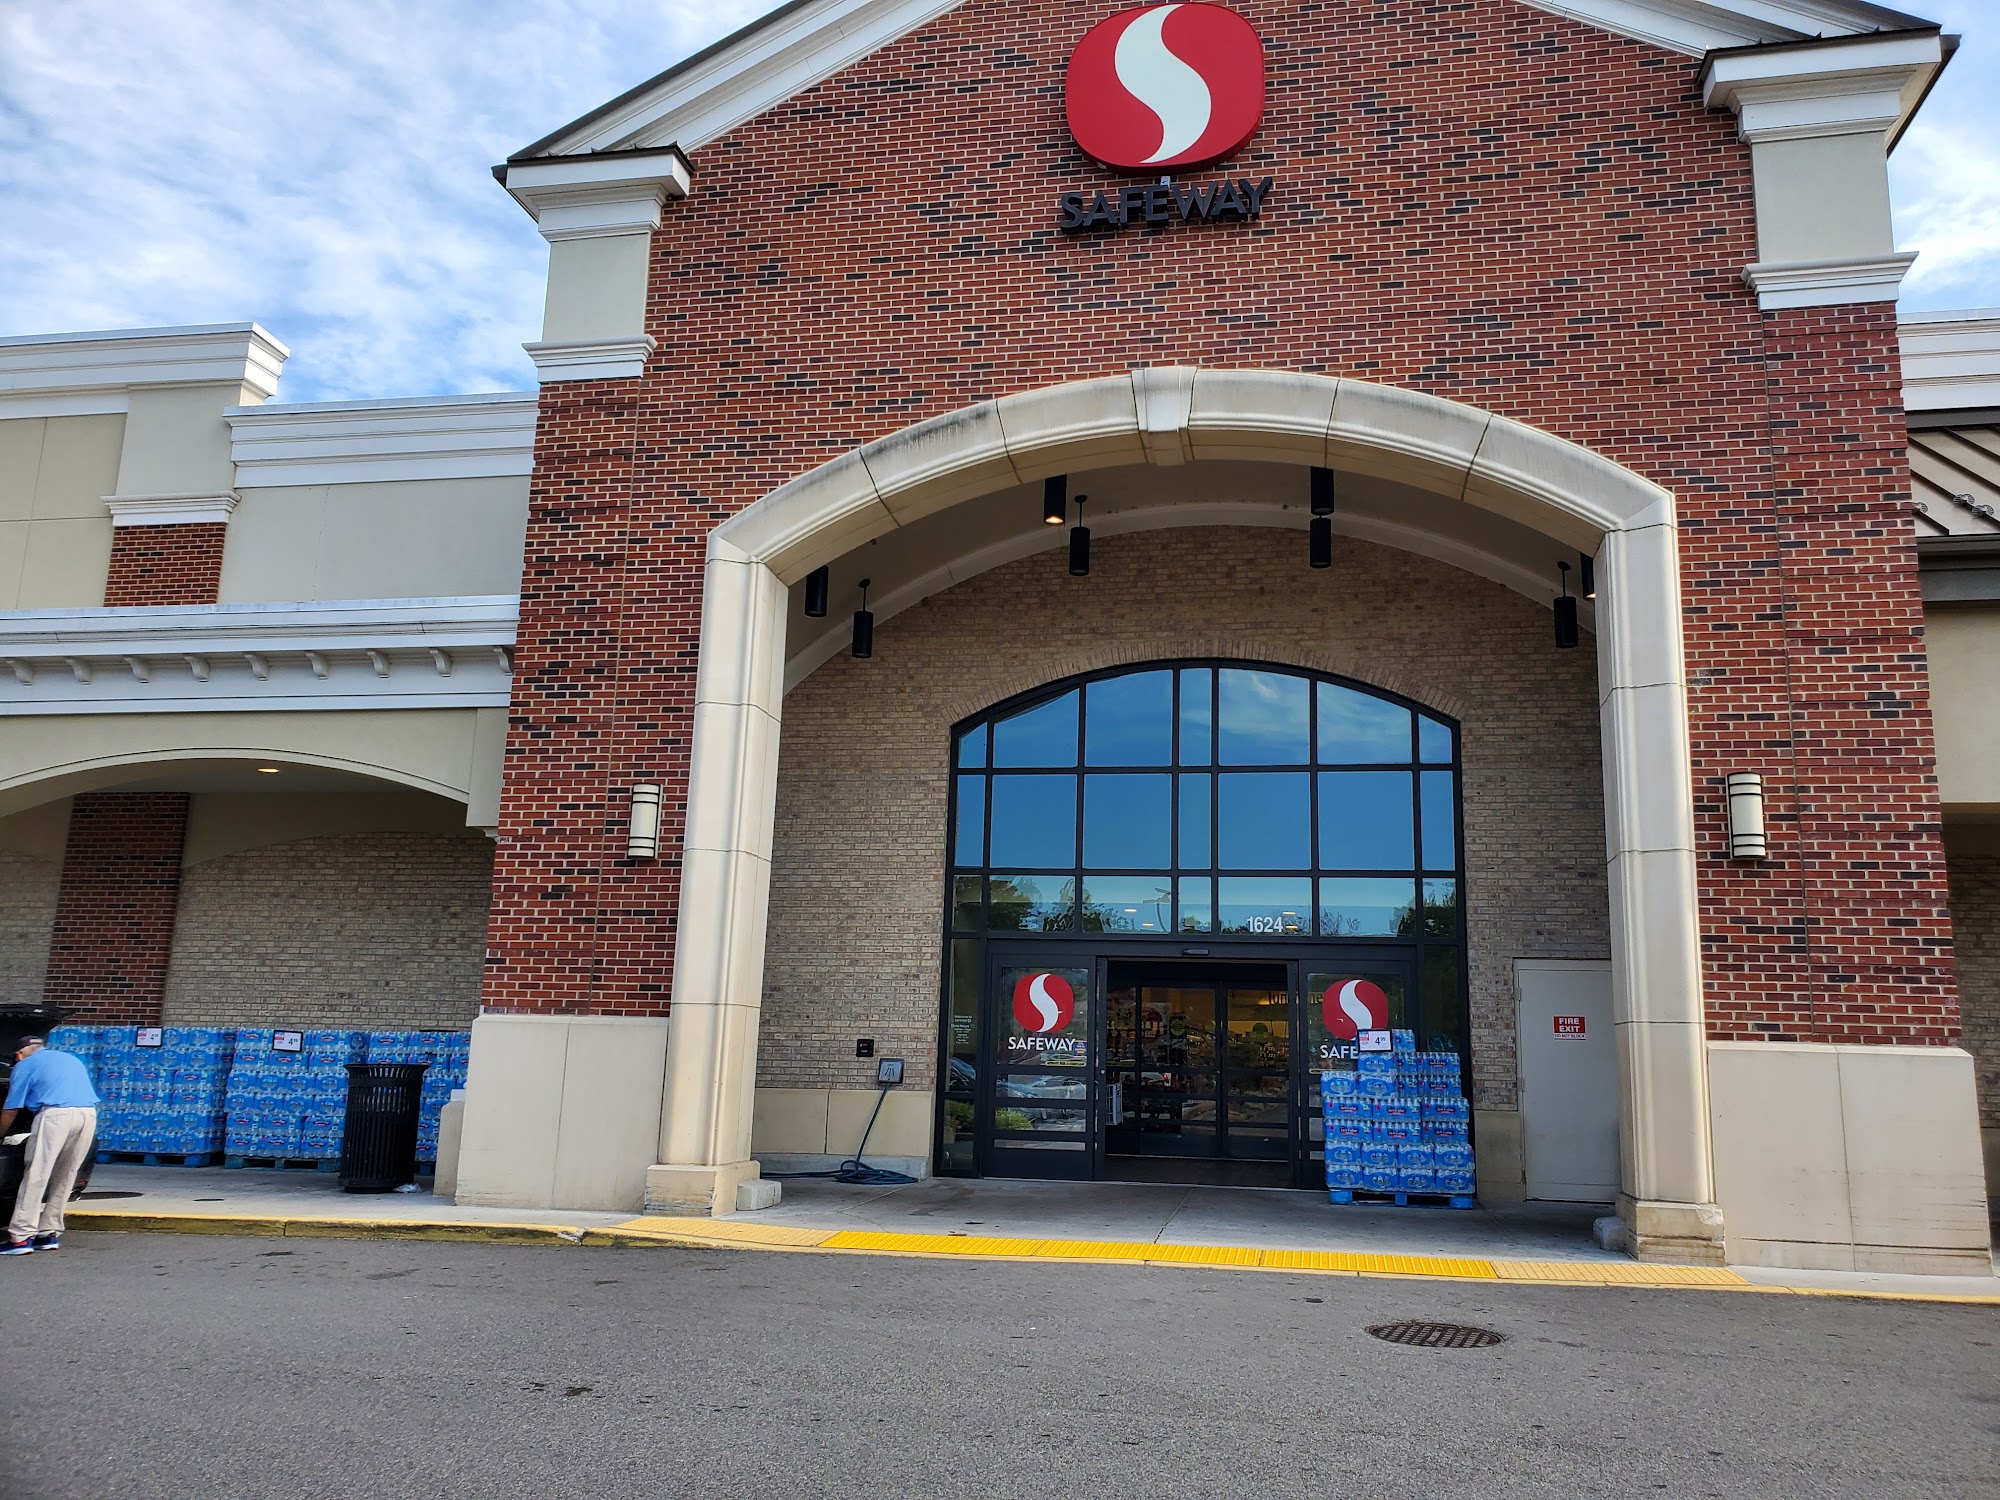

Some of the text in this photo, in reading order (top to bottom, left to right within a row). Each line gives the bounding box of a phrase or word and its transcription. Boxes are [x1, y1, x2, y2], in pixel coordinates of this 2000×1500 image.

[1059, 176, 1273, 235] SAFEWAY
[1246, 916, 1284, 933] 1624
[1008, 1036, 1076, 1051] SAFEWAY
[1320, 1044, 1359, 1060] SAFE
